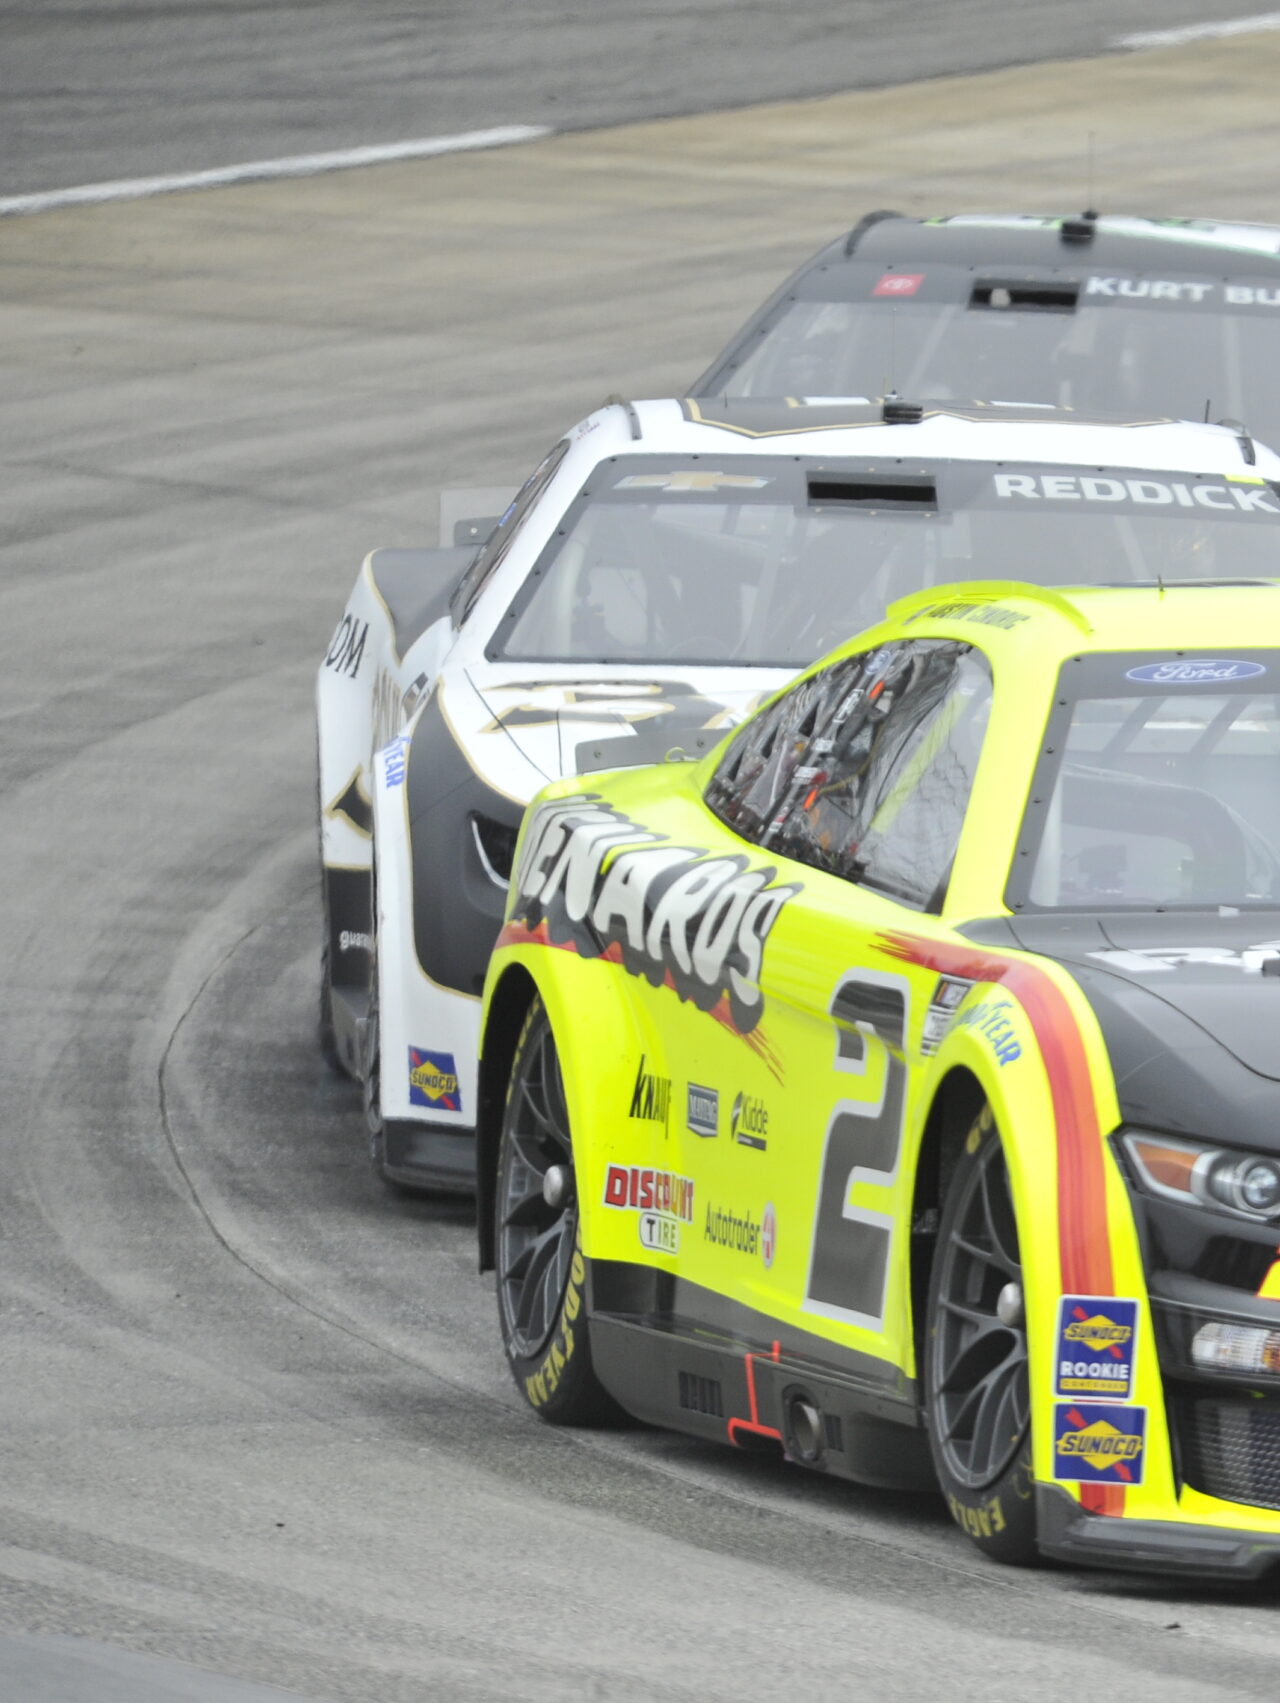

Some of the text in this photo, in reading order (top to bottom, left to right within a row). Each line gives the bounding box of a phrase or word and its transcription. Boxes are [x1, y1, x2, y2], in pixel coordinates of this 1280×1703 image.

[1085, 276, 1214, 302] KURT
[993, 474, 1280, 513] REDDICK
[1153, 661, 1238, 680] Ford
[411, 1070, 456, 1092] SUNOCO
[629, 1054, 672, 1140] KNAUF
[741, 1094, 768, 1135] Kidde
[800, 966, 911, 1333] 2
[604, 1165, 694, 1223] DISCOUNT
[646, 1217, 676, 1249] TIRE
[704, 1201, 760, 1256] Autotrader
[1067, 1324, 1130, 1341] SUNOCO
[1060, 1360, 1130, 1379] ROOKIE
[1062, 1434, 1139, 1457] SUNOCO
